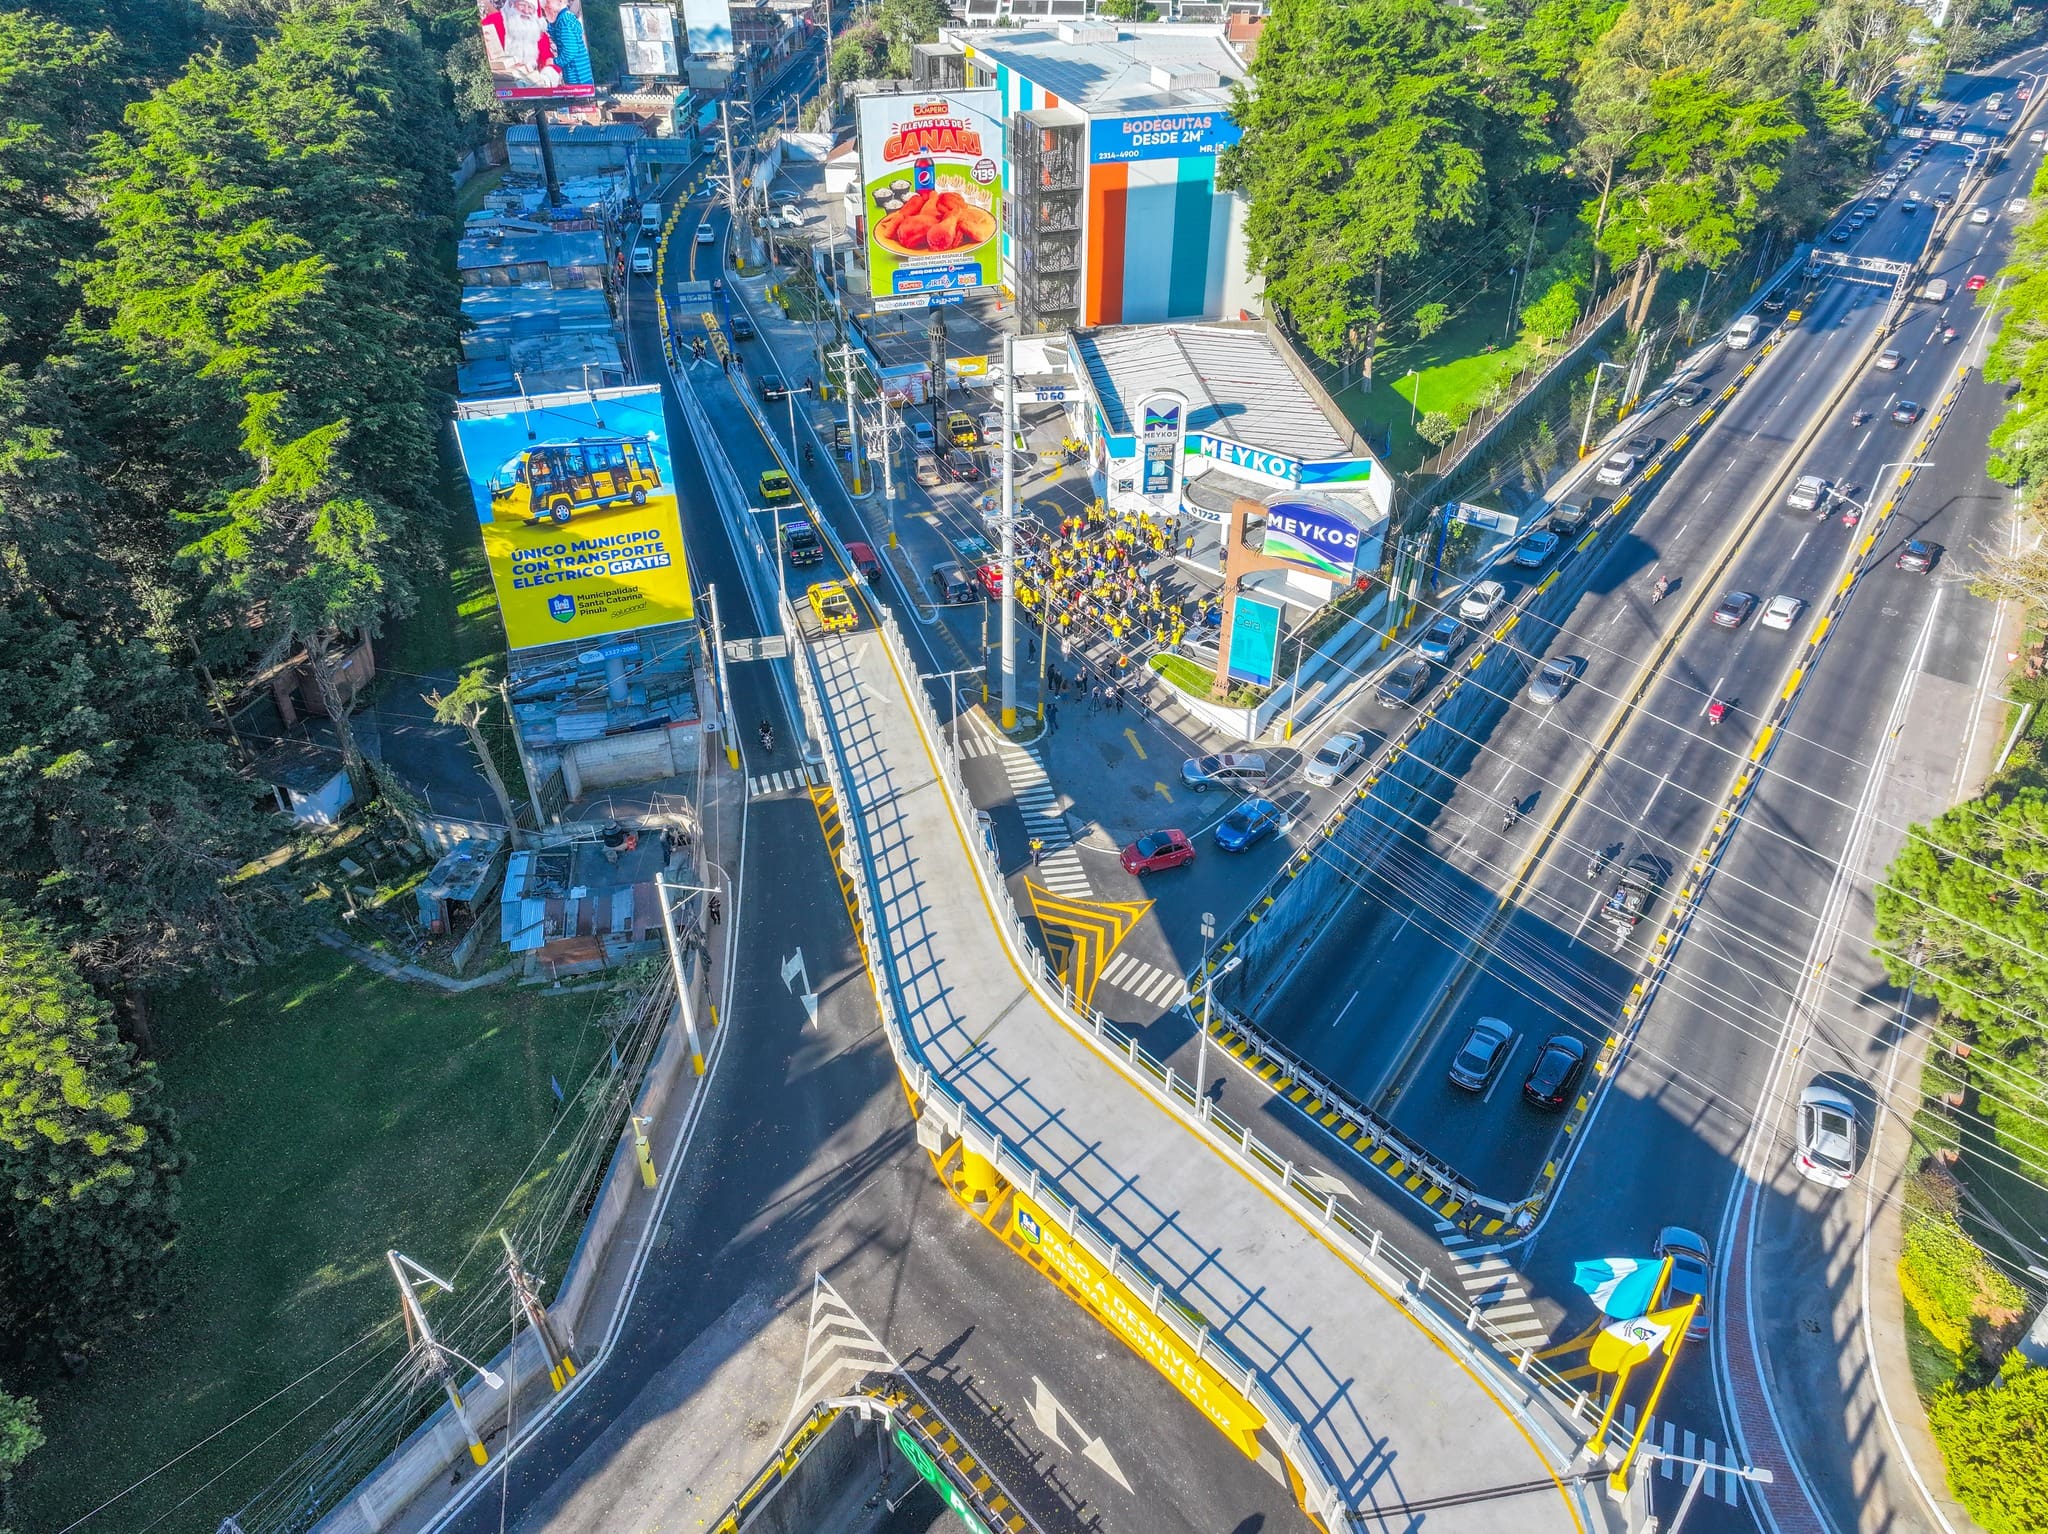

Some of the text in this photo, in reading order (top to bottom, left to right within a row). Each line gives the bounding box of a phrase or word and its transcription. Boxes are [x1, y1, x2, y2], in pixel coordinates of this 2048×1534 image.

[914, 106, 948, 115] CAMPERO
[935, 119, 951, 127] LAS
[951, 119, 964, 128] DE
[1122, 117, 1212, 134] BODEGUITAS
[884, 129, 982, 162] GANAR!
[1132, 132, 1178, 146] DESDE
[1144, 431, 1177, 439] MEYKOS
[1200, 437, 1303, 482] MEYKOS
[1199, 509, 1220, 521] 1722
[1267, 514, 1357, 548] MEYKOS
[511, 529, 660, 563] ÚNICO MUNICIPIO
[512, 542, 665, 576] CON TRANSPORTE
[513, 554, 669, 589] ELÉCTRICO GRATIS
[577, 586, 639, 602] Municipalidad
[578, 593, 643, 609] Santa Catarina
[579, 606, 608, 616] Pinula
[1043, 1231, 1207, 1393] PASO A DESNIVEL
[1043, 1246, 1099, 1301] NUESTRA
[1159, 1358, 1177, 1377] DE
[1181, 1379, 1199, 1400] LA
[1203, 1400, 1231, 1429] LUZ
